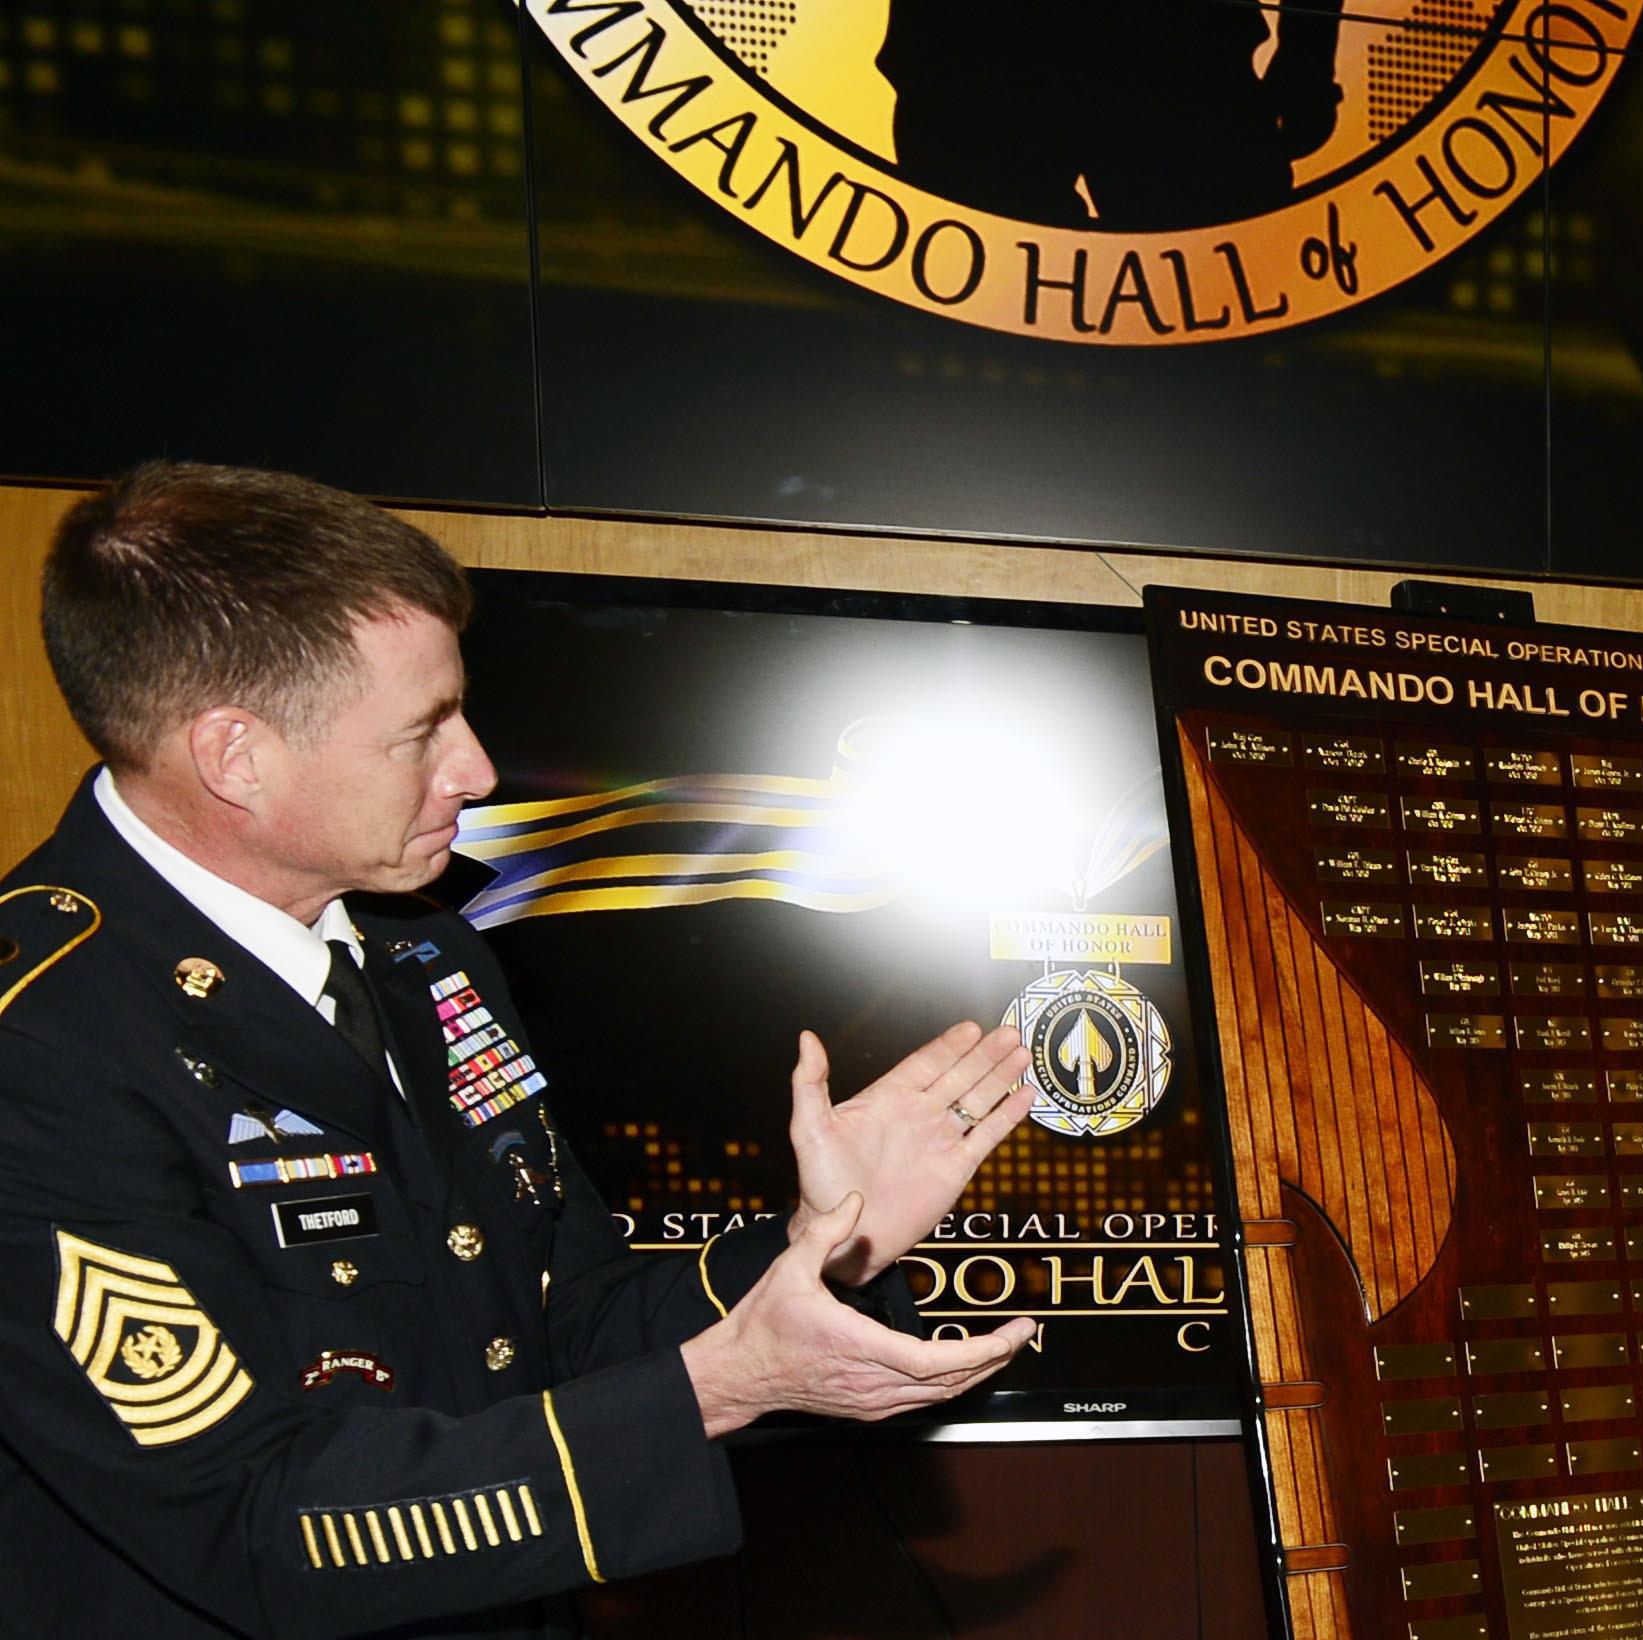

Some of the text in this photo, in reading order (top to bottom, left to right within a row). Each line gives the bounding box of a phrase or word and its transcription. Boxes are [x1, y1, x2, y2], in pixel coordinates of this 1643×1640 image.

[1019, 242, 1287, 338] HALL
[1301, 203, 1357, 297] of
[1373, 0, 1628, 253] HONO
[1179, 609, 1278, 638] UNITED
[1287, 619, 1386, 647] STATES
[1395, 630, 1500, 658] SPECIAL
[1203, 655, 1454, 706] COMMANDO
[1468, 679, 1570, 717] HALL
[1579, 689, 1629, 720] OF
[1116, 923, 1167, 937] HALL
[1031, 939, 1132, 954] OF HONOR
[1046, 992, 1124, 1020] UNITED STATES
[1034, 1045, 1138, 1115] SPECIAL OPERATIONS COMMAND
[298, 1208, 360, 1232] THETFORD
[934, 1213, 1080, 1239] ECIAL
[321, 1357, 375, 1372] RANGER
[1063, 1402, 1127, 1414] SHARP
[1595, 1496, 1633, 1513] HALL
